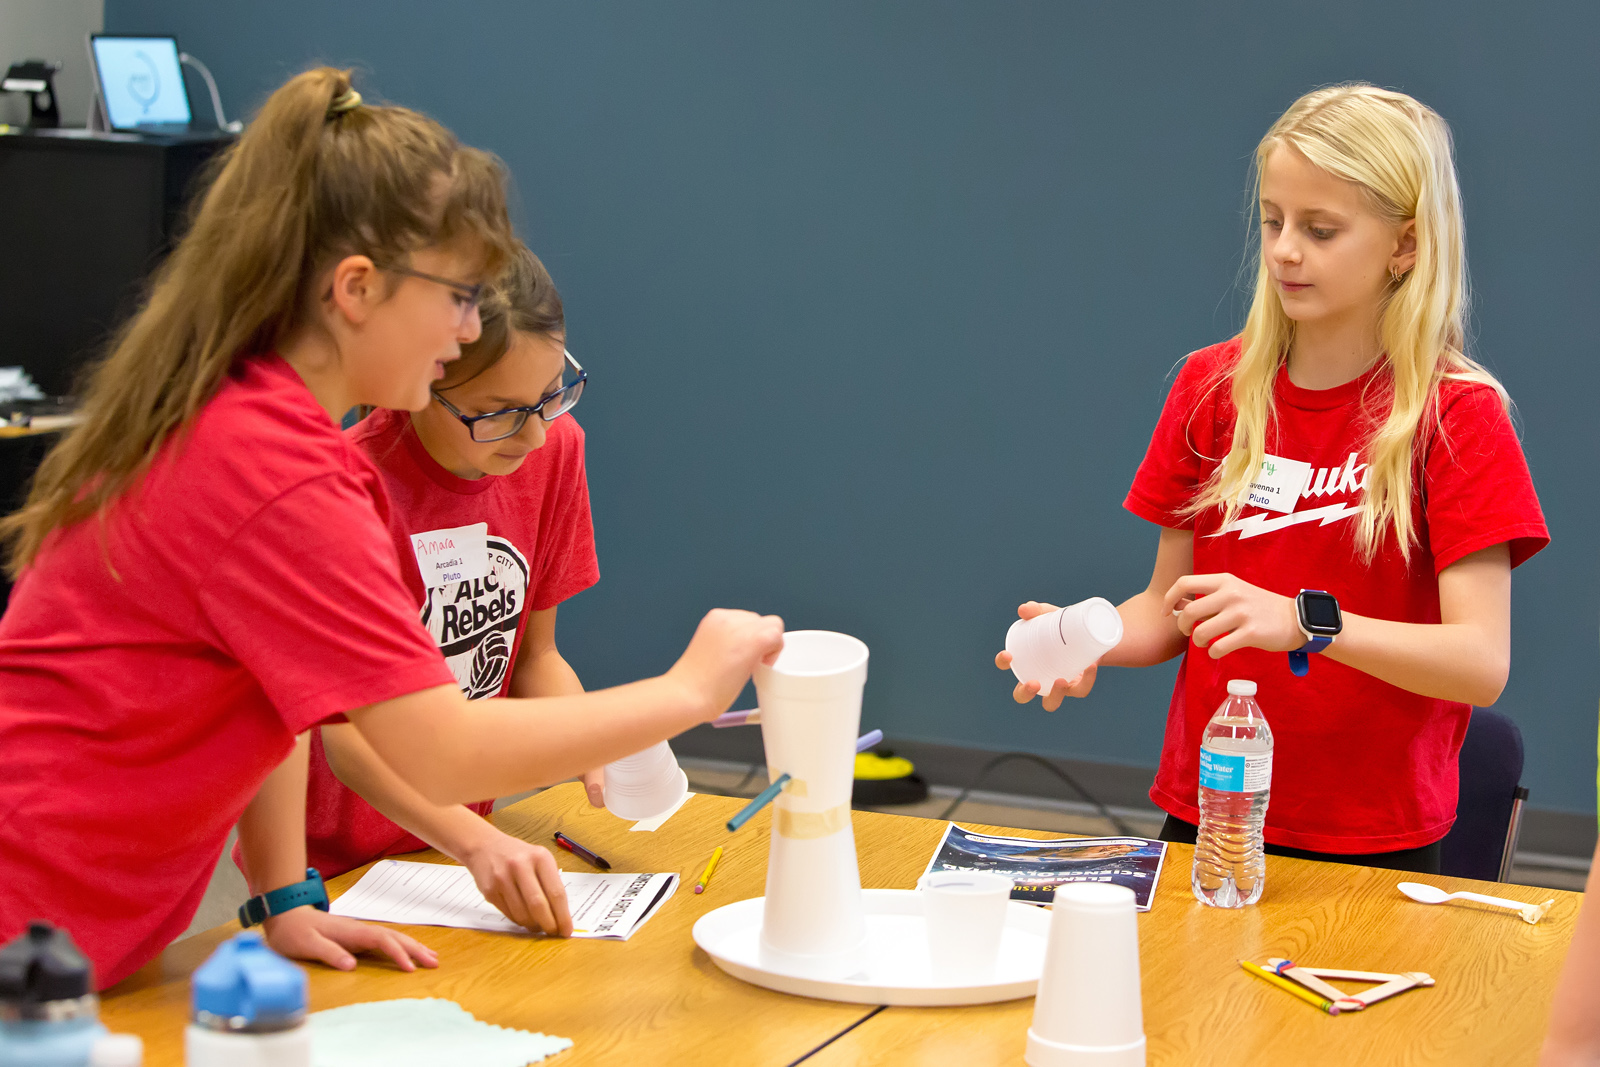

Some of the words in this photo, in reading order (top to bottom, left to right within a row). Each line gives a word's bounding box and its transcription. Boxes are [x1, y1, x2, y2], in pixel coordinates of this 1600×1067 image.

[1249, 482, 1275, 493] avenna
[1248, 493, 1270, 505] Pluto
[435, 559, 458, 570] Arcadia
[496, 555, 514, 570] CITY
[442, 572, 462, 582] Pluto
[441, 589, 516, 644] Rebels
[1213, 763, 1234, 773] Water
[1058, 868, 1147, 878] SCIENCE
